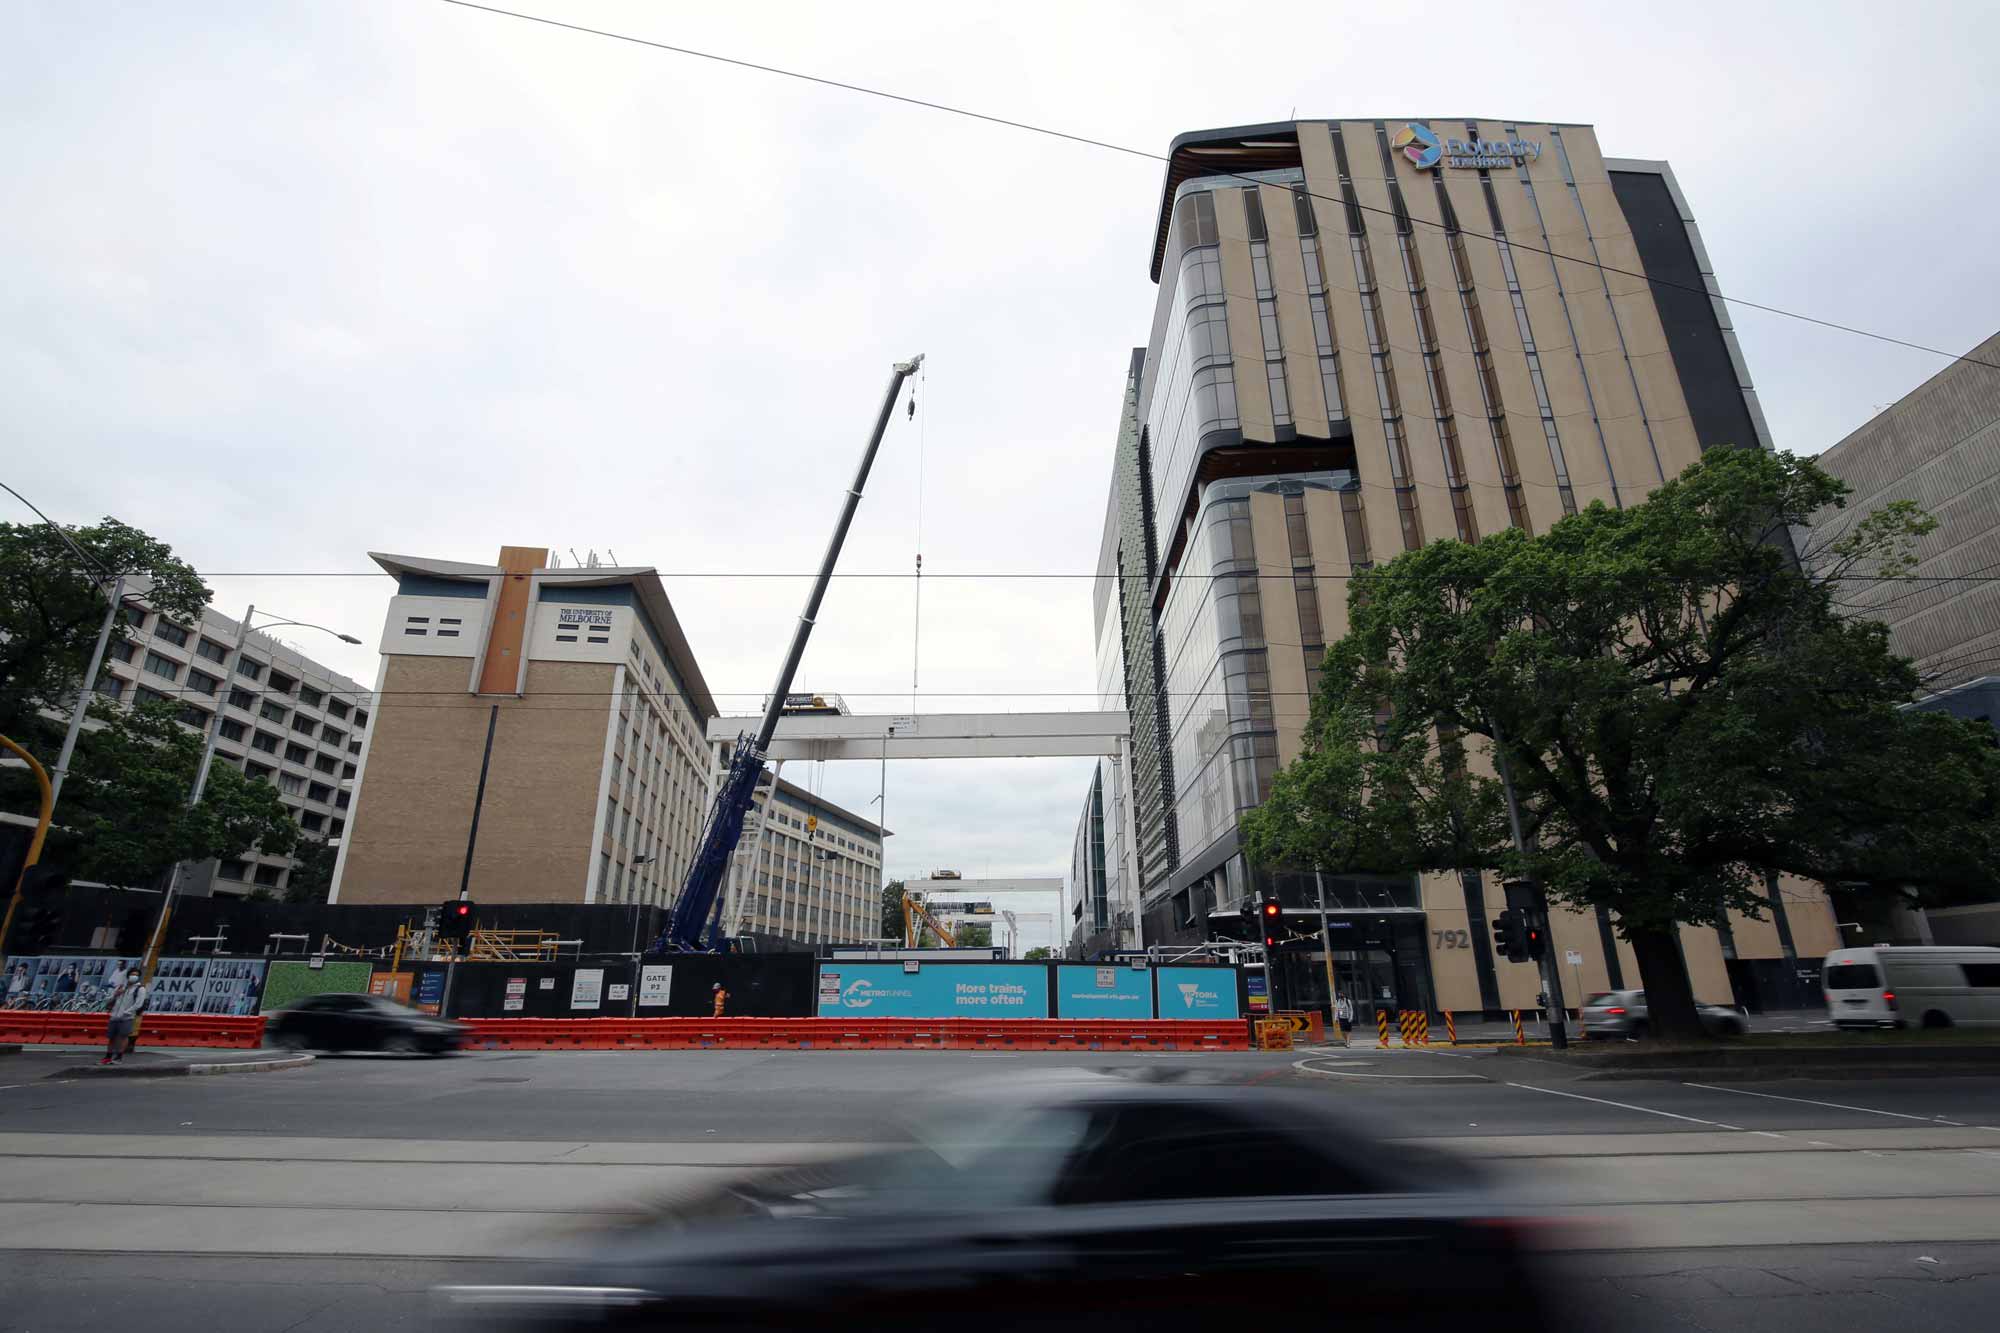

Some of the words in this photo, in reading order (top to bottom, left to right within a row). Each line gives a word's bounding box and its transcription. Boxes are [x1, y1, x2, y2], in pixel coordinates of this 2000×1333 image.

[559, 614, 613, 625] MELBOURNE
[1431, 929, 1471, 950] 792
[208, 980, 233, 993] YOU
[955, 983, 986, 994] More
[988, 983, 1028, 997] trains,
[955, 996, 987, 1005] more
[990, 994, 1025, 1005] often
